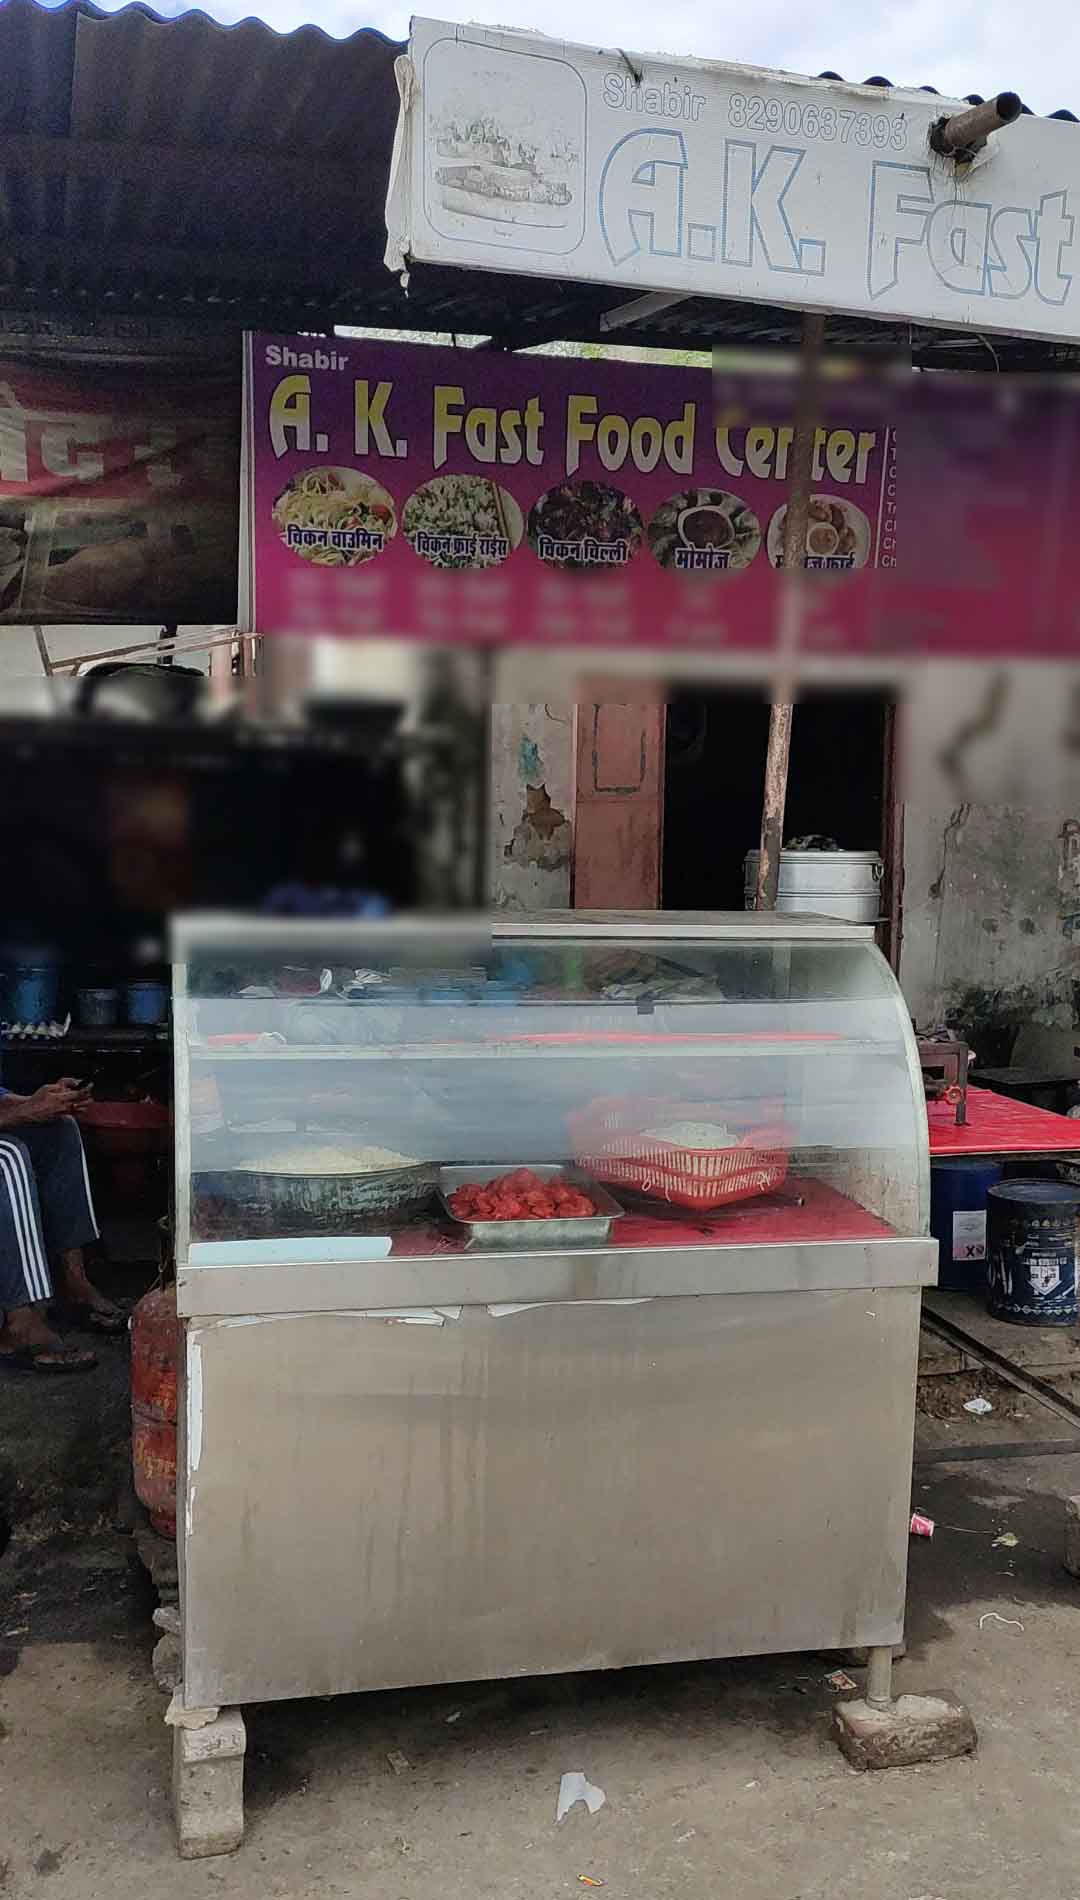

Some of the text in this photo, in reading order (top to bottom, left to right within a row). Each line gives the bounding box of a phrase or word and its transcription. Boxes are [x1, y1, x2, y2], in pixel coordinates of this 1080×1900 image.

[603, 71, 908, 151] Shabir 8290637393
[867, 159, 1076, 305] Fast
[264, 344, 350, 371] Shabir
[433, 384, 546, 471] Fast
[566, 393, 697, 479] Food
